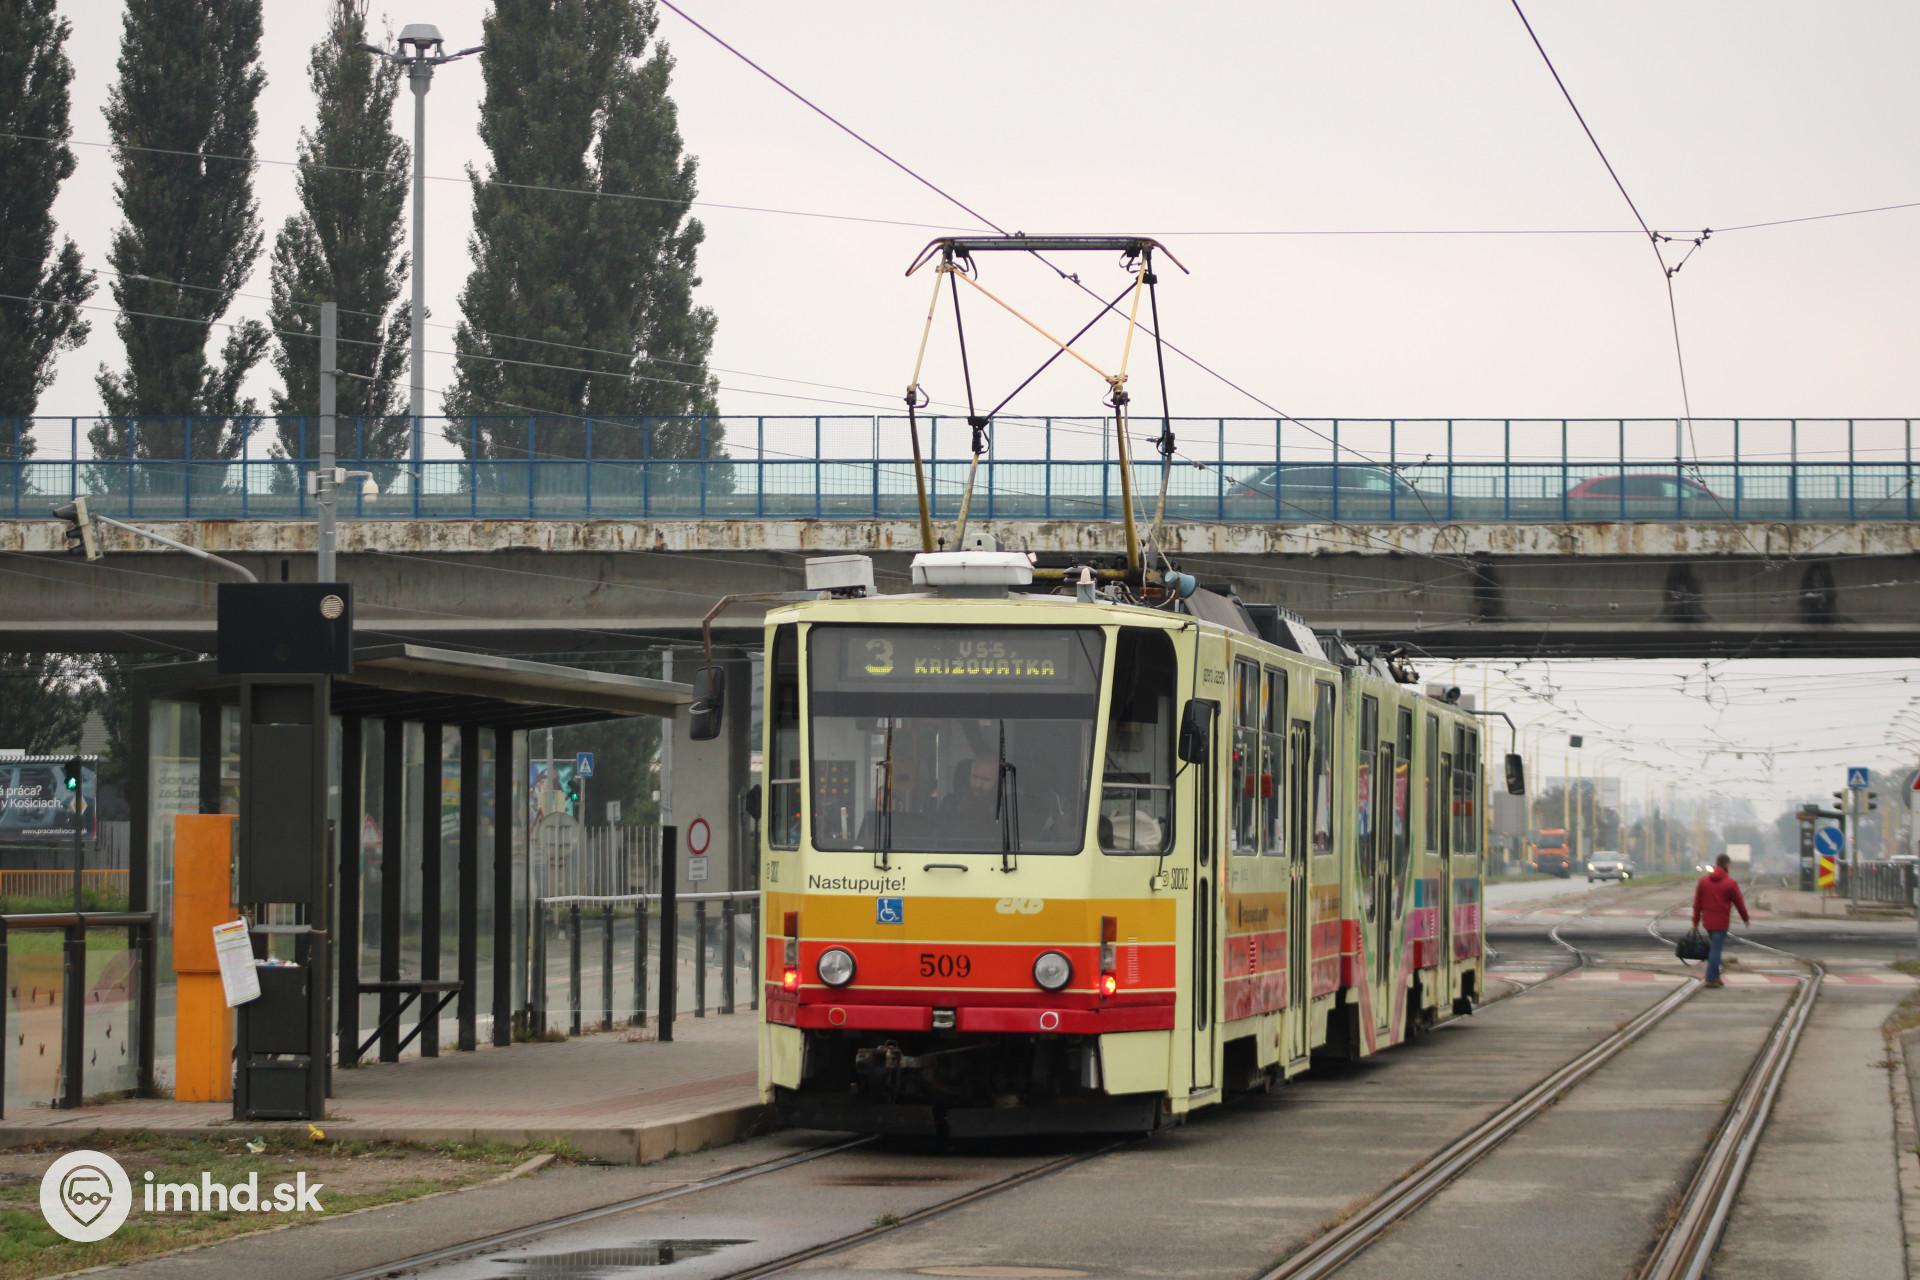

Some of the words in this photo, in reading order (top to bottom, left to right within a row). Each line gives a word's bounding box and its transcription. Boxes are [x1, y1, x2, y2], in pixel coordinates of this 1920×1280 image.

[865, 638, 894, 676] 3
[6, 785, 42, 798] práca?
[10, 797, 64, 808] Košiciach.
[808, 874, 906, 894] Nastupujte!
[920, 953, 972, 978] 509
